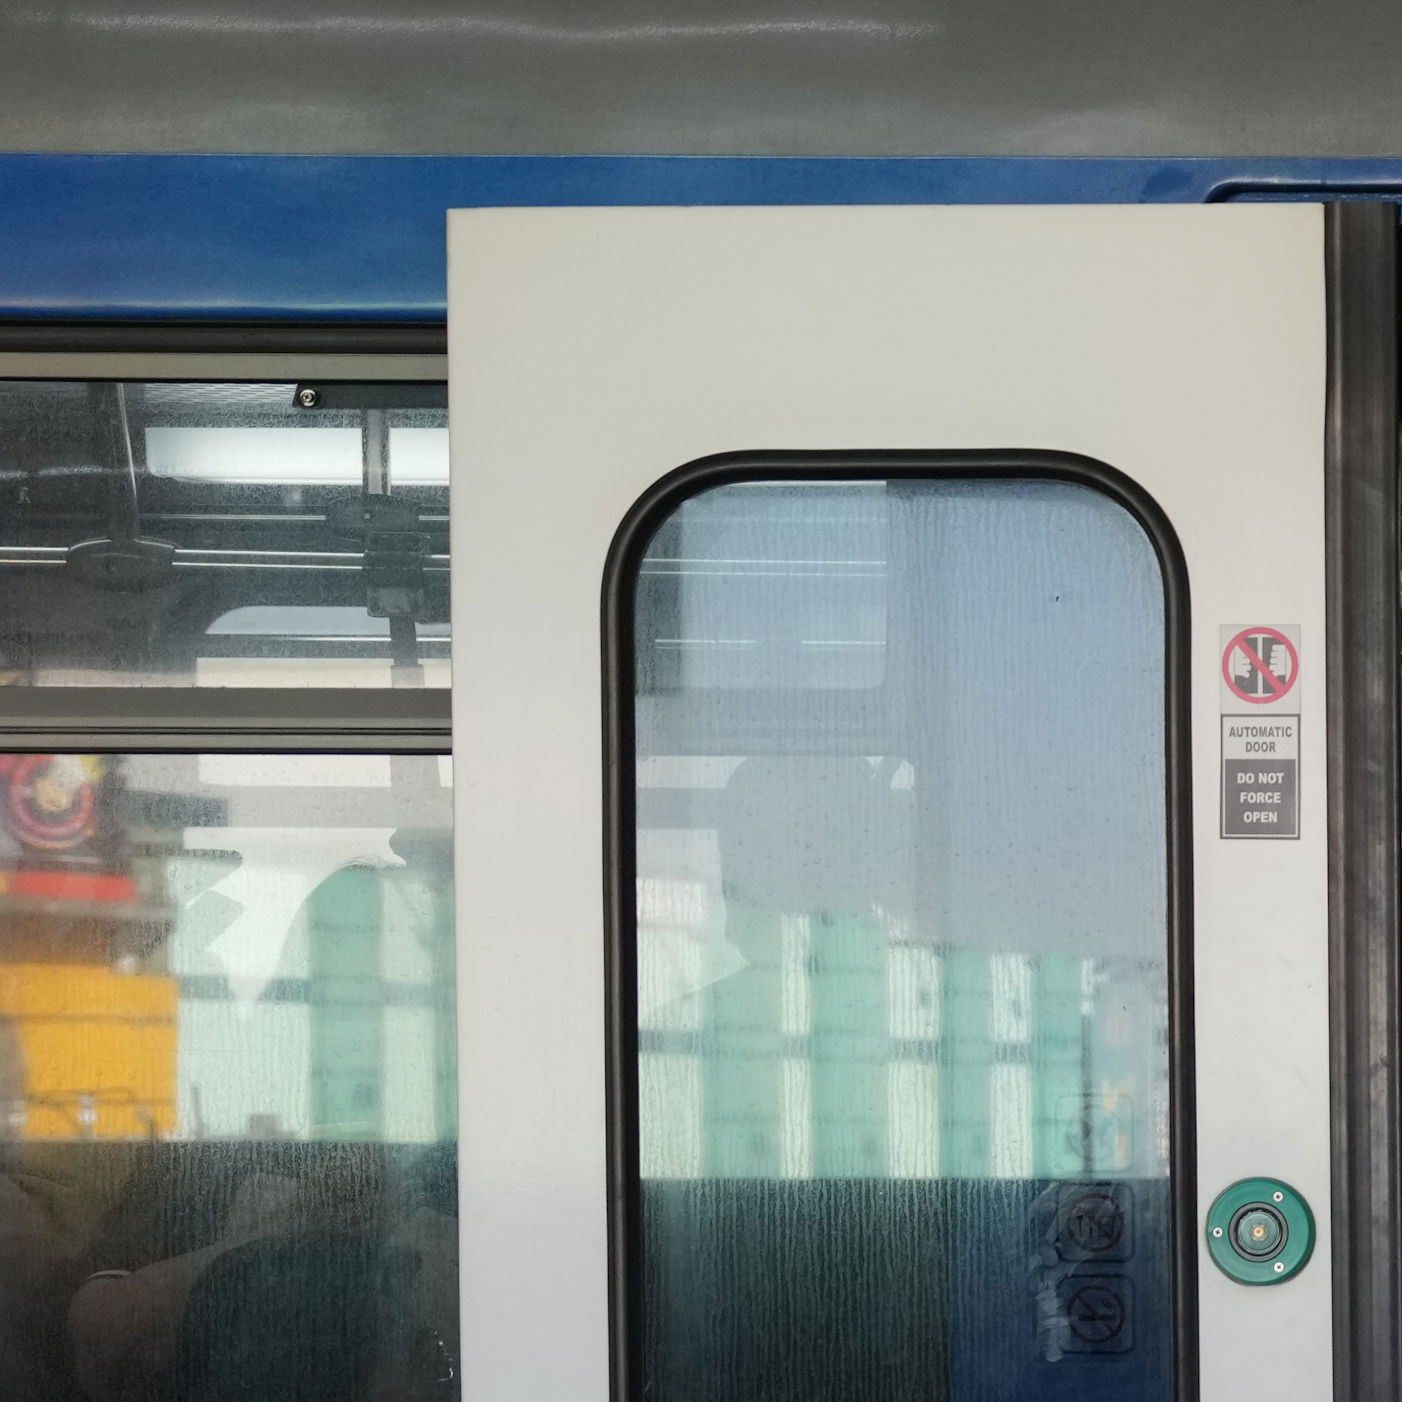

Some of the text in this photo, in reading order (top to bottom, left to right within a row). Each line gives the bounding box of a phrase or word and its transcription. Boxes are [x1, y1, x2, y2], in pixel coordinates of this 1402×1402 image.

[1229, 726, 1293, 737] AUTOMATIC
[1245, 742, 1276, 752] DOOR
[1237, 773, 1285, 784] DO NOT
[1240, 792, 1281, 804] FORCE
[1243, 812, 1278, 823] OPEN
